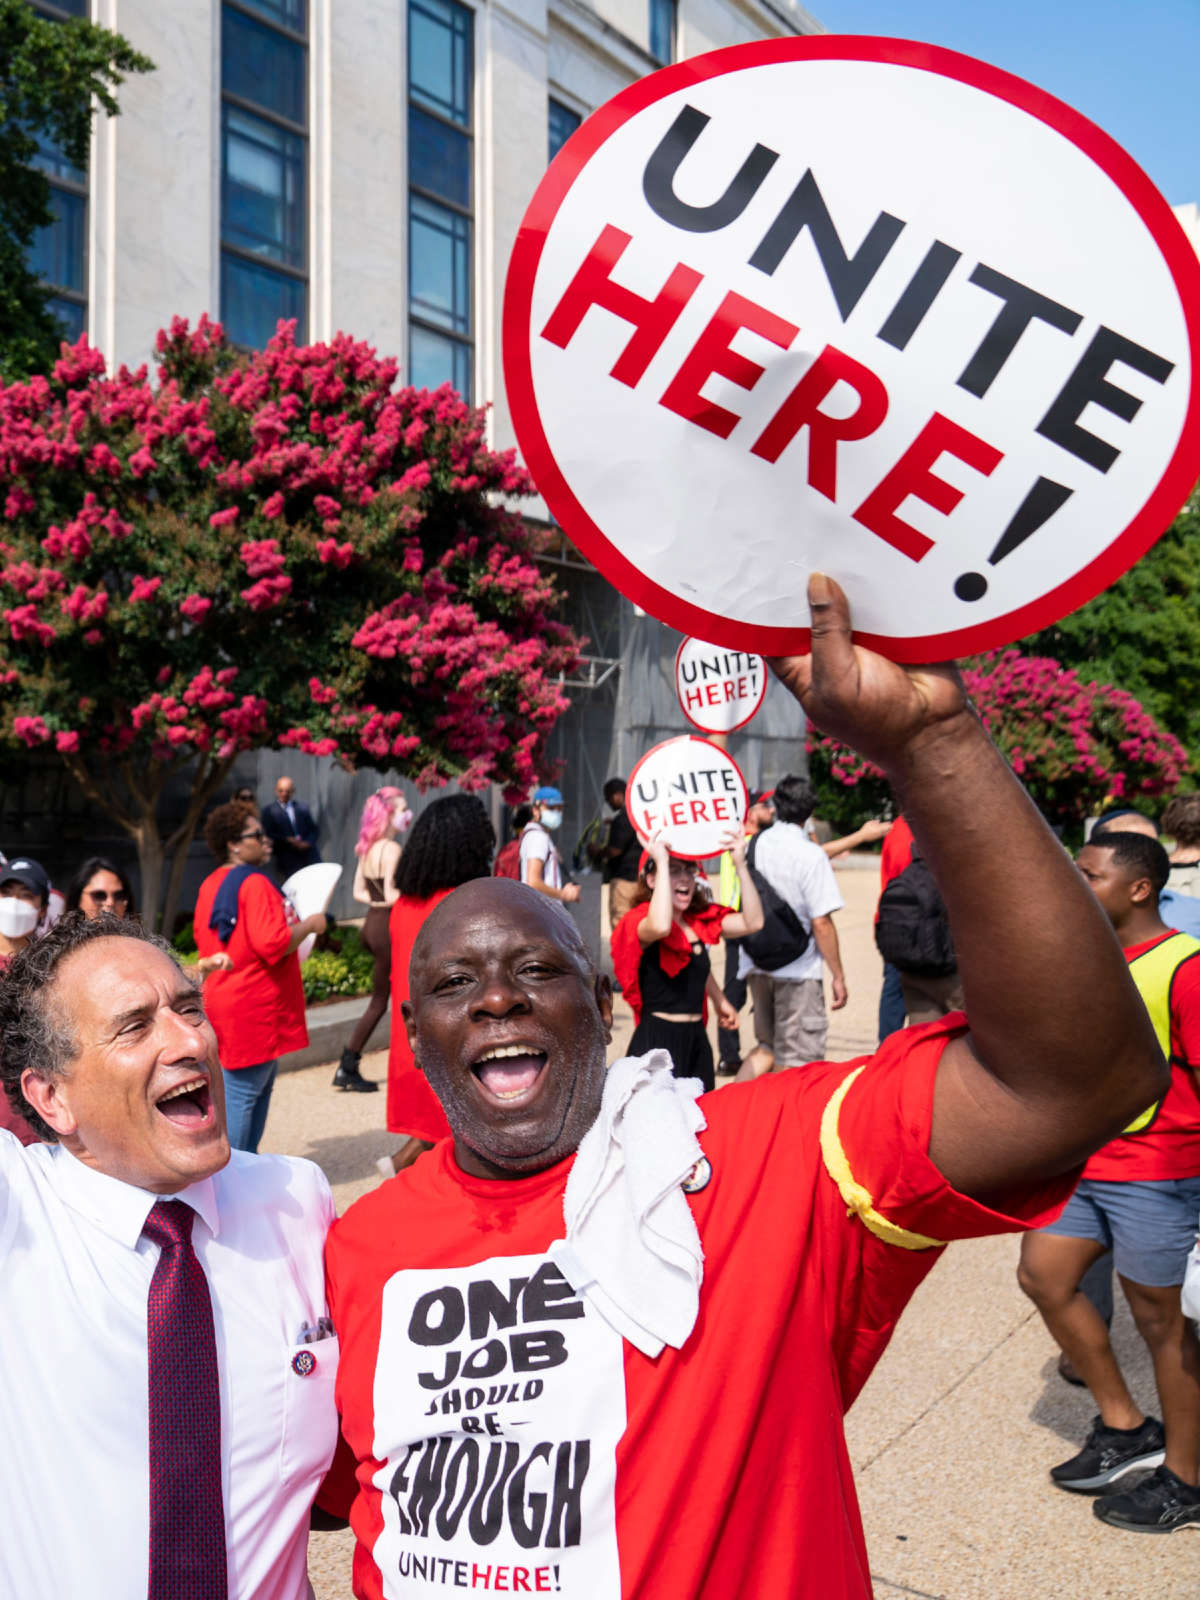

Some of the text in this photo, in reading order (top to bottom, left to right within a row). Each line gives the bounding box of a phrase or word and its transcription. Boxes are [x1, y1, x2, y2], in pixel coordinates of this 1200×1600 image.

[642, 103, 1176, 474] UNITE
[540, 223, 1075, 602] HERE!
[681, 652, 758, 684] UNITE
[685, 674, 758, 710] HERE!
[637, 769, 737, 803] UNITE
[643, 797, 740, 830] HERE!
[407, 1262, 586, 1347] ONE
[417, 1329, 569, 1390] JOB
[424, 1378, 544, 1416] SHOULD
[460, 1412, 505, 1437] BE
[389, 1436, 591, 1549] ENOUGH
[398, 1551, 562, 1592] UNITEHERE!
